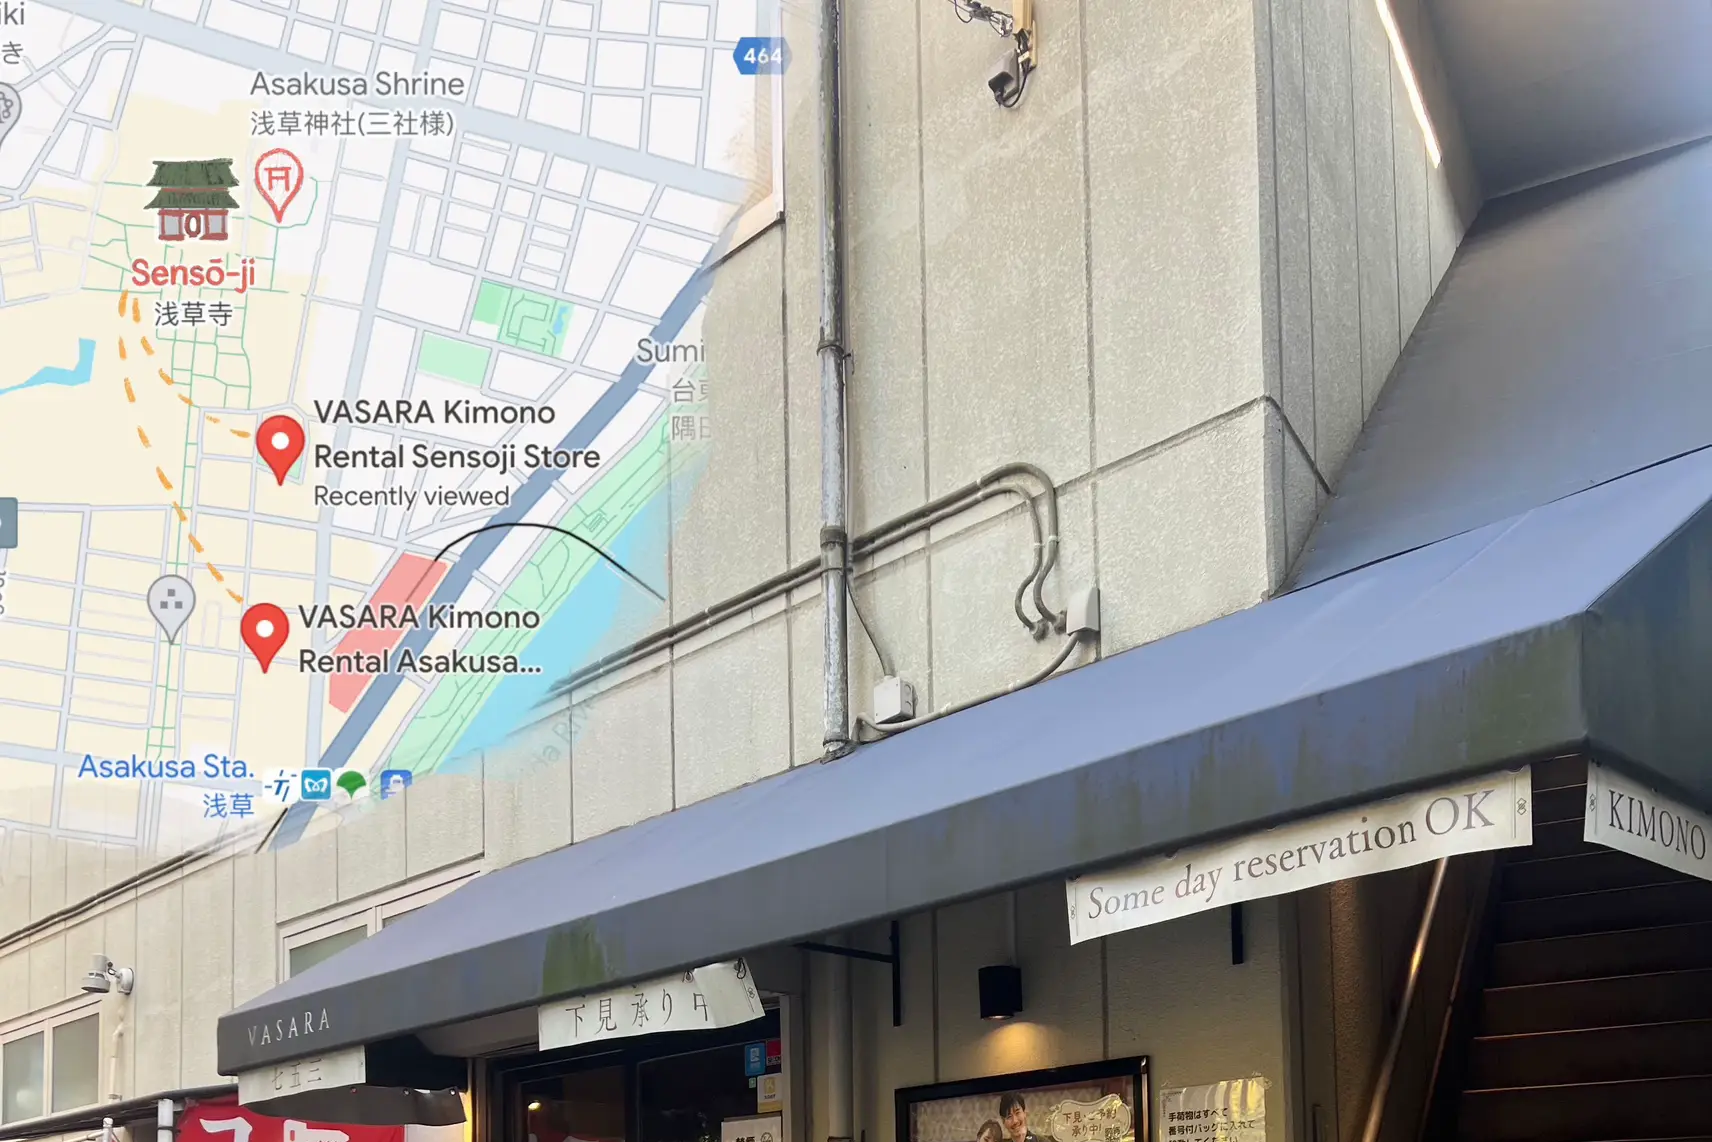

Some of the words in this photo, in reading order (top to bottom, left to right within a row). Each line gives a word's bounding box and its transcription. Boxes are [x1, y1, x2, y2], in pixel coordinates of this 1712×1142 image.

[1608, 789, 1706, 860] KIMONO
[1088, 886, 1165, 919] Some
[1175, 864, 1223, 903] day
[1233, 816, 1417, 882] reservation
[1425, 789, 1495, 836] OK
[248, 1008, 330, 1047] VASARA
[271, 1058, 322, 1090] 七五三
[1168, 1108, 1228, 1122] 手荷物はすべて
